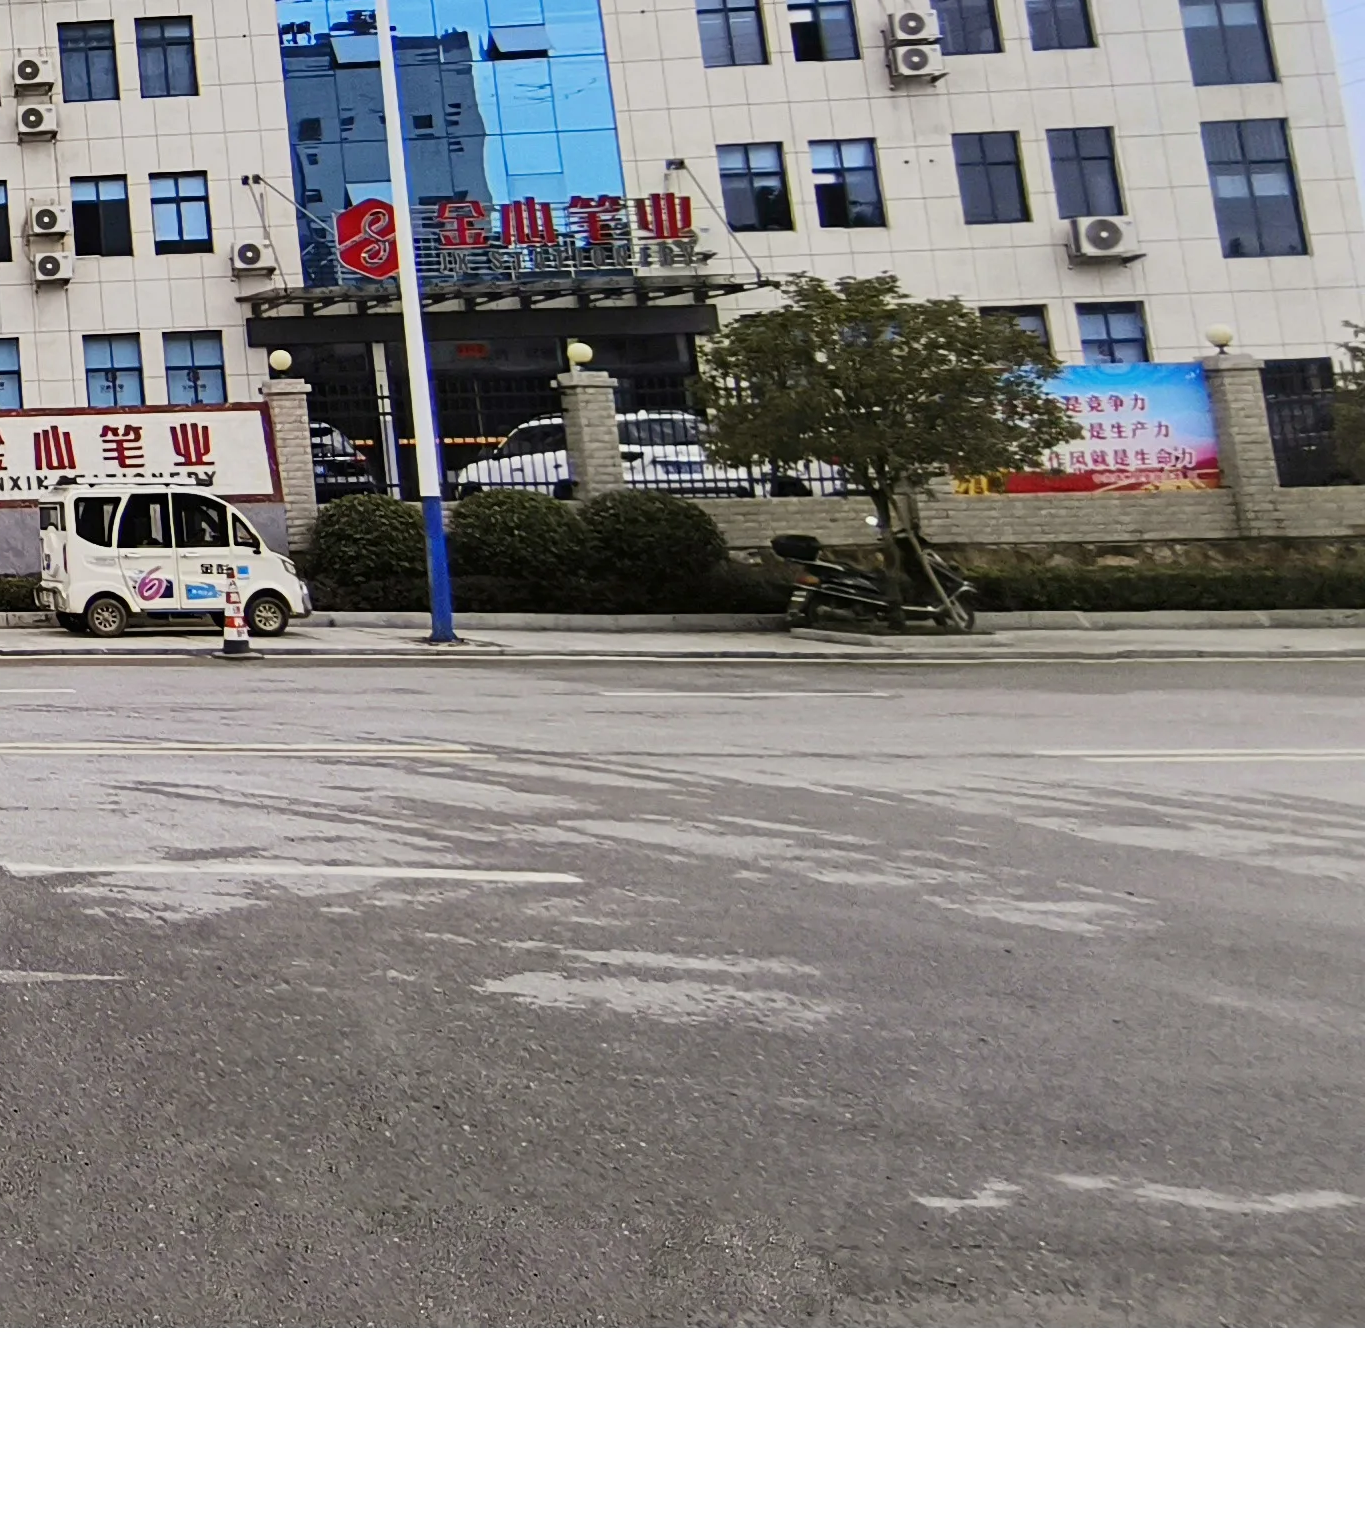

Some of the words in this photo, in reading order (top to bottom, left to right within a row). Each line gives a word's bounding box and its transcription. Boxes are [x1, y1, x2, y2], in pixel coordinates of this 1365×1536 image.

[1065, 393, 1147, 413] 是竞争力
[1085, 420, 1171, 440] 是生产力
